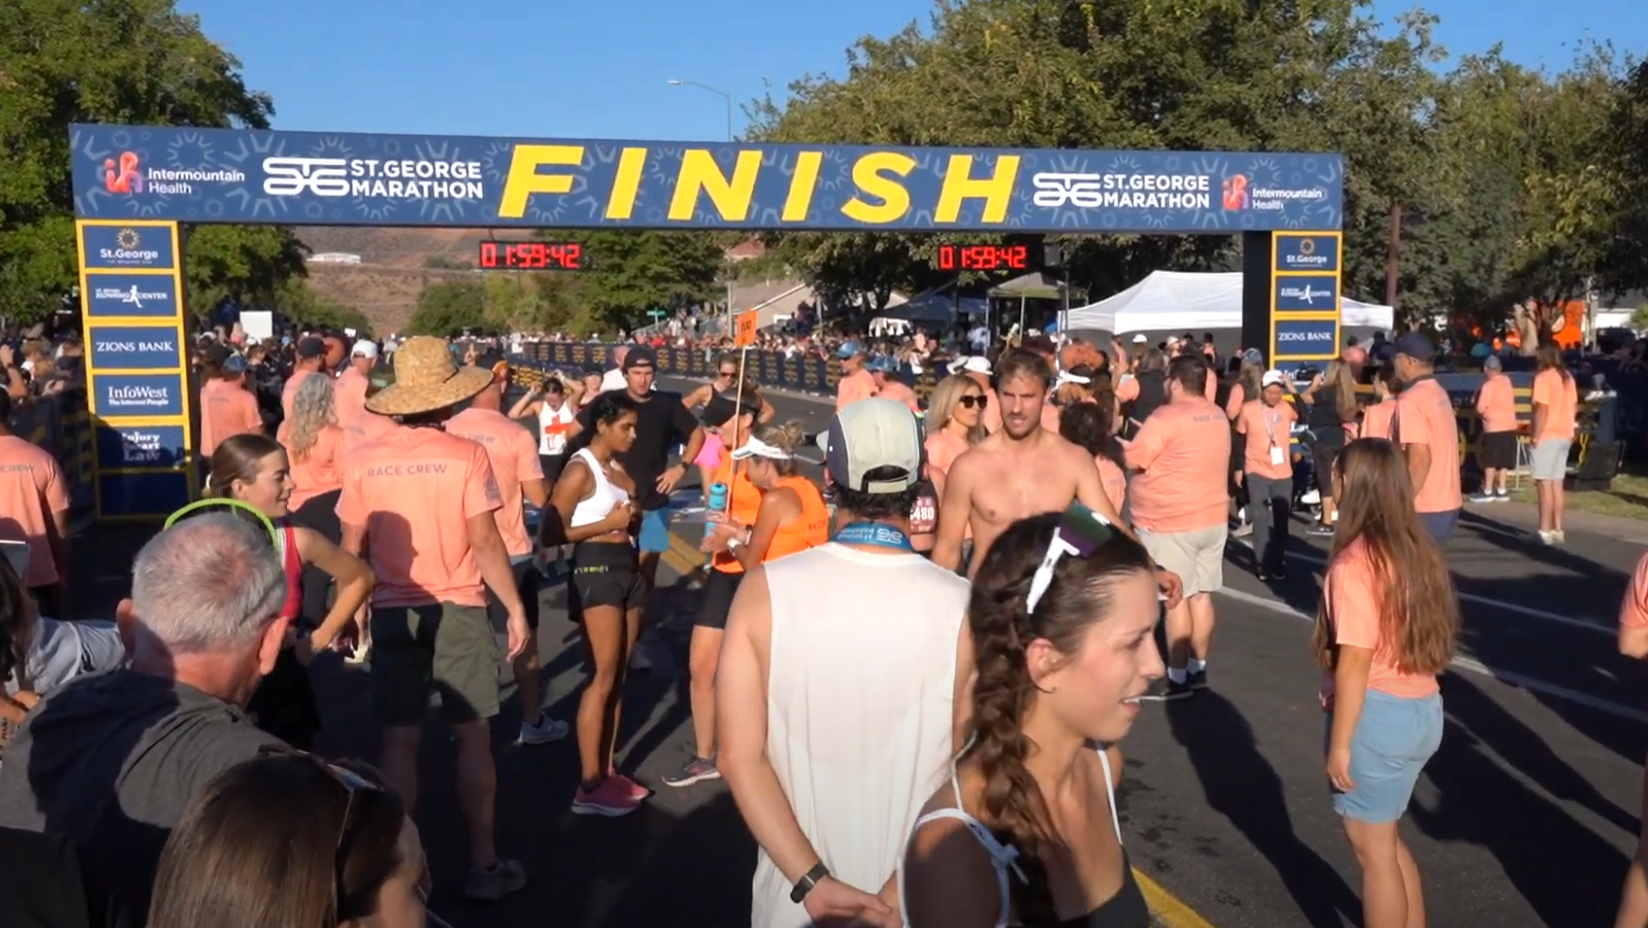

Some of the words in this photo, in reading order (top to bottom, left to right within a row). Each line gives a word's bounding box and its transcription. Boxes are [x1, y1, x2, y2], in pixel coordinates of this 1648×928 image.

[148, 167, 246, 182] Intermountain
[351, 159, 483, 179] ST.GEORGE
[148, 182, 192, 194] Health
[351, 179, 484, 199] MARATHON
[498, 144, 1020, 224] FINISH
[1103, 174, 1210, 192] ST.GEORGE
[1252, 187, 1323, 199] Intermountain
[1103, 192, 1210, 209] MARATHON
[1252, 199, 1284, 210] Health
[100, 248, 159, 261] St.George
[1278, 332, 1306, 341] ZIONS
[1307, 332, 1332, 341] BANK
[96, 341, 136, 352] ZIONS
[138, 341, 175, 352] BANK
[107, 386, 169, 399] InfoWest
[123, 449, 161, 461] Law
[367, 465, 403, 477] RACE
[406, 463, 448, 475] CREW
